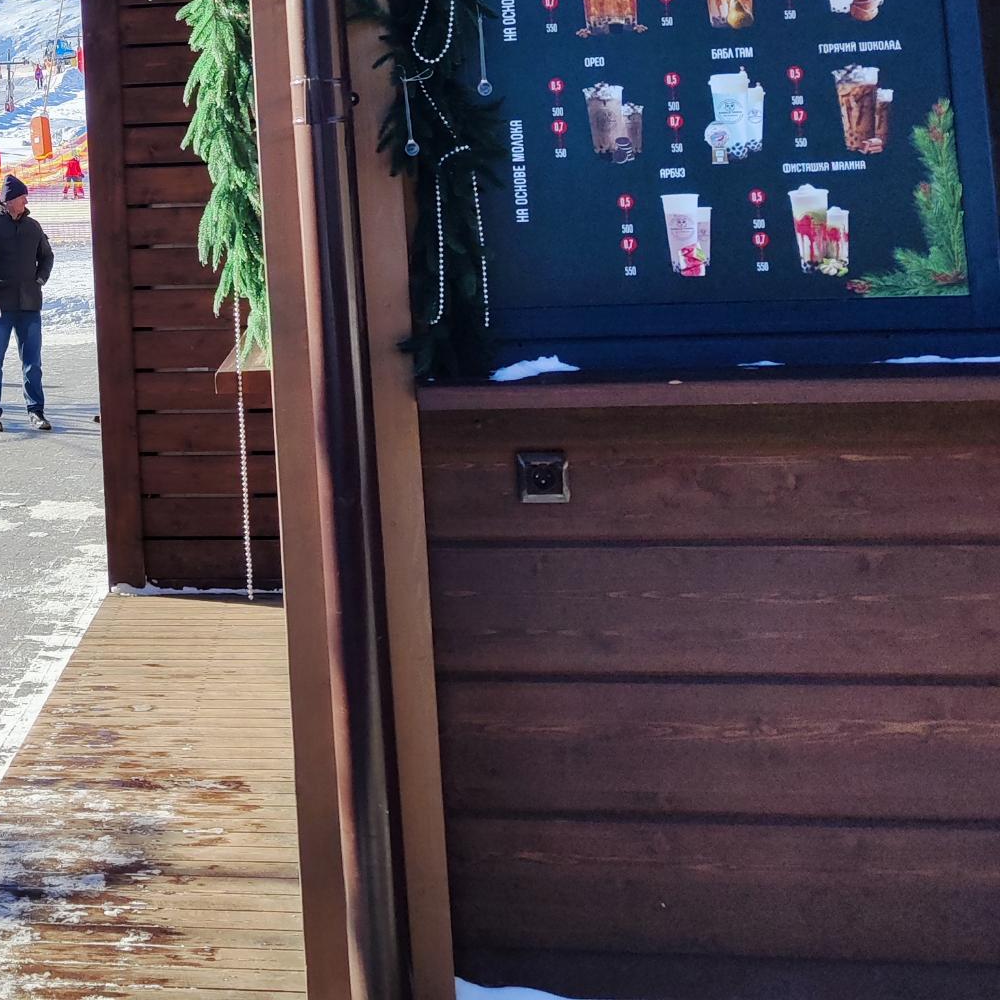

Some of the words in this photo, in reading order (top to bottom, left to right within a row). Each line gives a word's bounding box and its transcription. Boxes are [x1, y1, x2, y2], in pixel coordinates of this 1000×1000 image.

[784, 10, 796, 20] 550
[661, 16, 673, 26] 550
[546, 23, 558, 33] 550
[503, 26, 518, 42] НА
[818, 42, 857, 54] ГОРЯЧИЙ
[858, 40, 902, 52] ШОКОЛАД
[711, 47, 734, 60] БАБЛ
[735, 46, 754, 58] ГАМ
[584, 57, 605, 68] ОРЕО
[791, 95, 804, 105] 500
[667, 101, 680, 111] 500
[552, 107, 564, 117] 500
[510, 119, 525, 162] МОЛОКА
[795, 137, 807, 148] 550
[555, 148, 567, 158] 550
[671, 143, 683, 153] 550
[782, 161, 830, 174] ФИСТАШКА
[831, 160, 867, 172] МАЛИНА
[659, 167, 686, 179] АРБУЗ
[513, 165, 528, 206] ОСНОВЕ
[516, 208, 529, 223] НА
[621, 224, 634, 234] 500
[753, 219, 765, 229] 500
[624, 266, 637, 276] 550
[756, 261, 769, 271] 550
